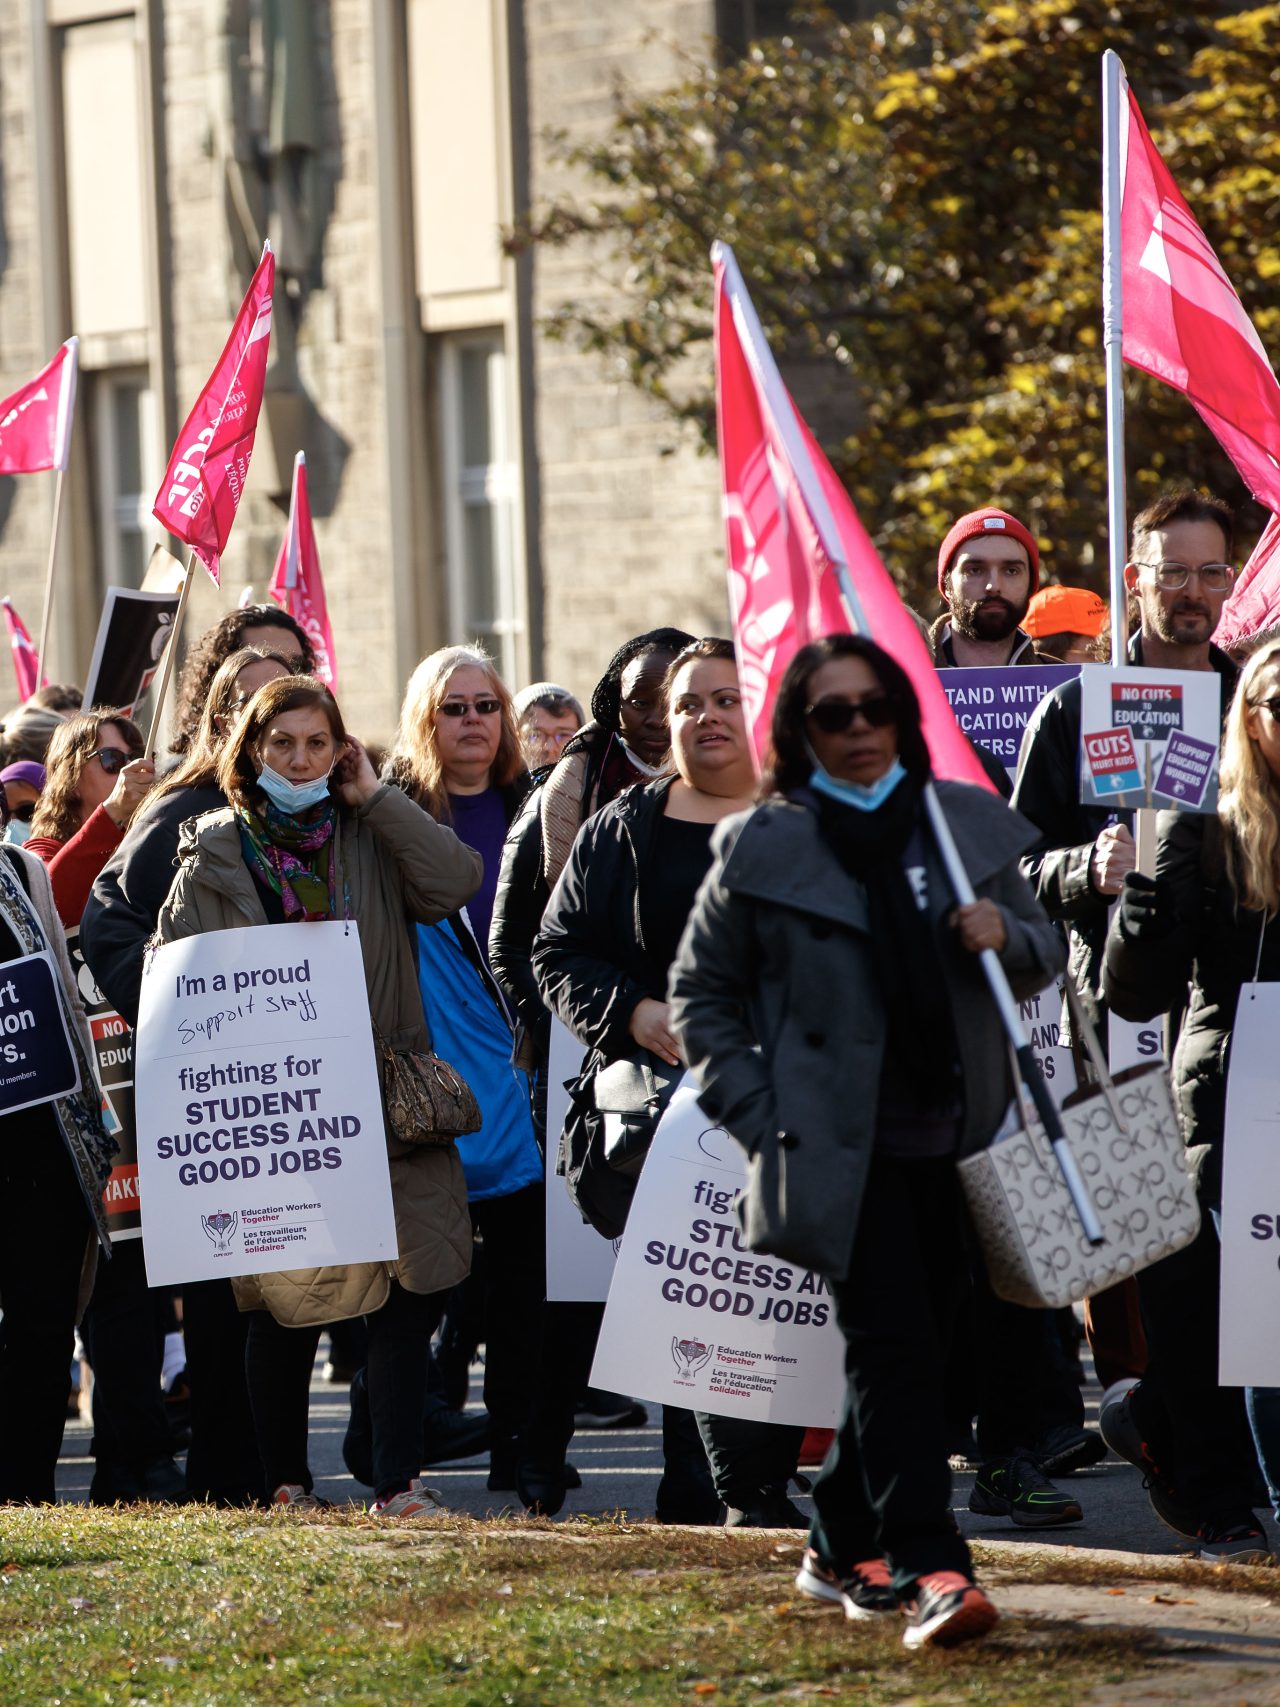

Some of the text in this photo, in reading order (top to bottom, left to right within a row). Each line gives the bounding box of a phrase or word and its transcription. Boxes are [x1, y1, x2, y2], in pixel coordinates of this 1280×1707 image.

[944, 685, 1048, 705] TAND WITH
[1122, 688, 1172, 701] NO CUTS
[1142, 702, 1152, 710] TO
[955, 711, 1028, 731] CATION
[1114, 710, 1180, 726] EDUCATION
[1088, 734, 1131, 758] CUTS
[1177, 742, 1211, 762] SUPPORT
[1092, 755, 1135, 770] HURT KIDS
[1167, 752, 1208, 776] EDUCATION
[1164, 765, 1202, 787] WORKERS
[176, 959, 311, 998] I'm a proud
[102, 1020, 124, 1039] NO
[1030, 1022, 1060, 1050] AND
[6, 1070, 37, 1085] members
[178, 1054, 322, 1094] fighting for
[185, 1088, 321, 1126] STUDENT
[156, 1115, 361, 1160] SUCCESS AND
[178, 1146, 342, 1187] GOOD JOBS
[241, 1202, 322, 1217] Education Workers
[241, 1213, 280, 1225] Together
[243, 1225, 308, 1240] Les travailleurs
[244, 1233, 307, 1247] de l'éducation,
[244, 1243, 286, 1254] solidaires
[644, 1240, 794, 1292] SUCCESS
[661, 1277, 830, 1327] GOOD JOBS
[716, 1353, 756, 1367] Together
[717, 1345, 798, 1364] Education Workers
[710, 1376, 723, 1385] de
[724, 1378, 774, 1394] l'éducation,
[712, 1368, 777, 1386] Les travailleurs
[708, 1385, 751, 1398] solidaires
